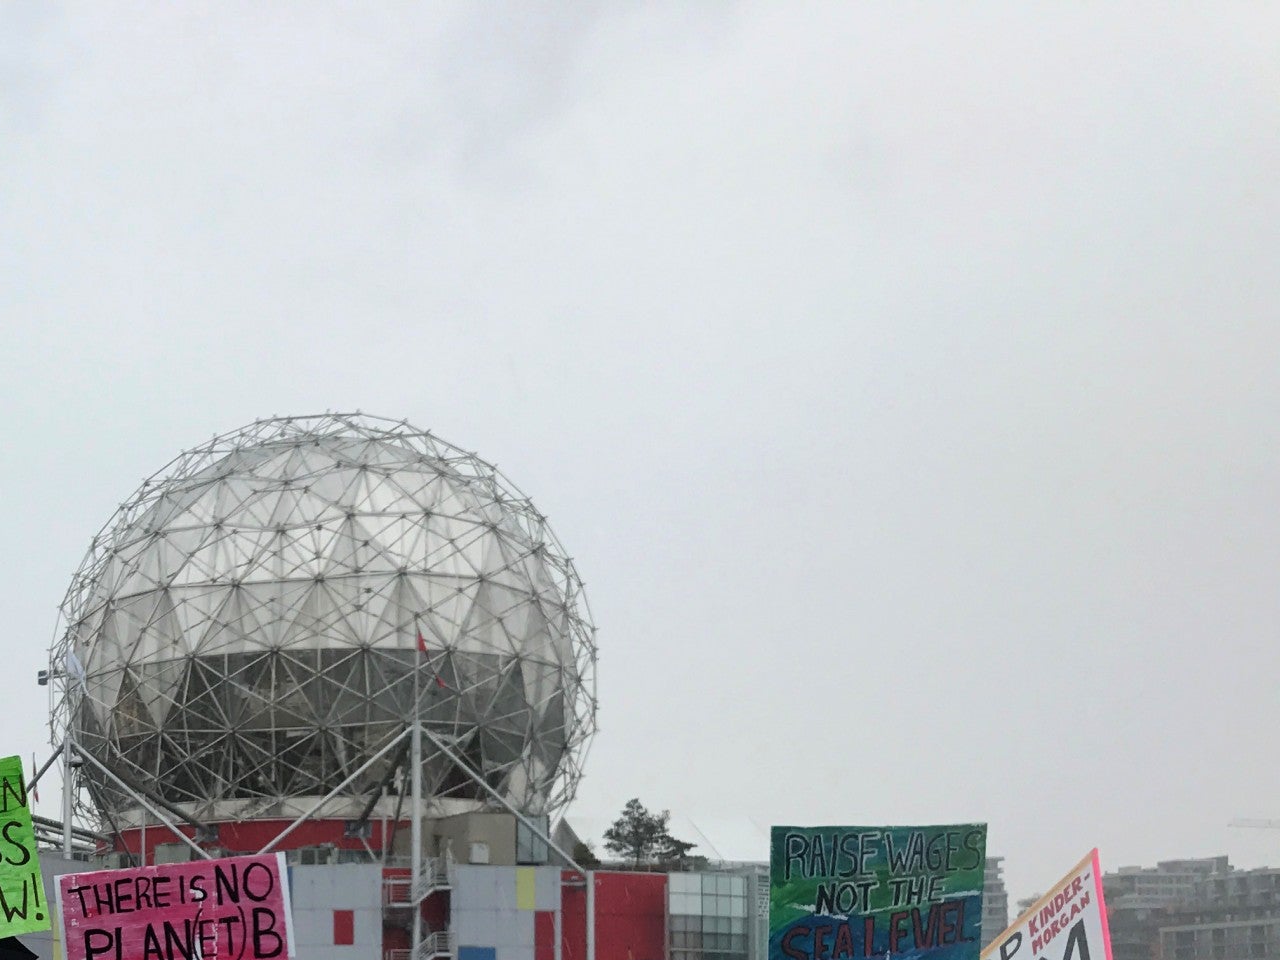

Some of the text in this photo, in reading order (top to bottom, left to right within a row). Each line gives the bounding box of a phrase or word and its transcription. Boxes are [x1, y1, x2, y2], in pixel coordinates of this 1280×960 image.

[784, 830, 983, 880] RAISE WAGES
[68, 862, 274, 917] THERE IS NO
[815, 875, 947, 914] NOT THE
[252, 907, 283, 959] B
[864, 901, 974, 957] LEVEL
[1031, 891, 1091, 956] MORGAN
